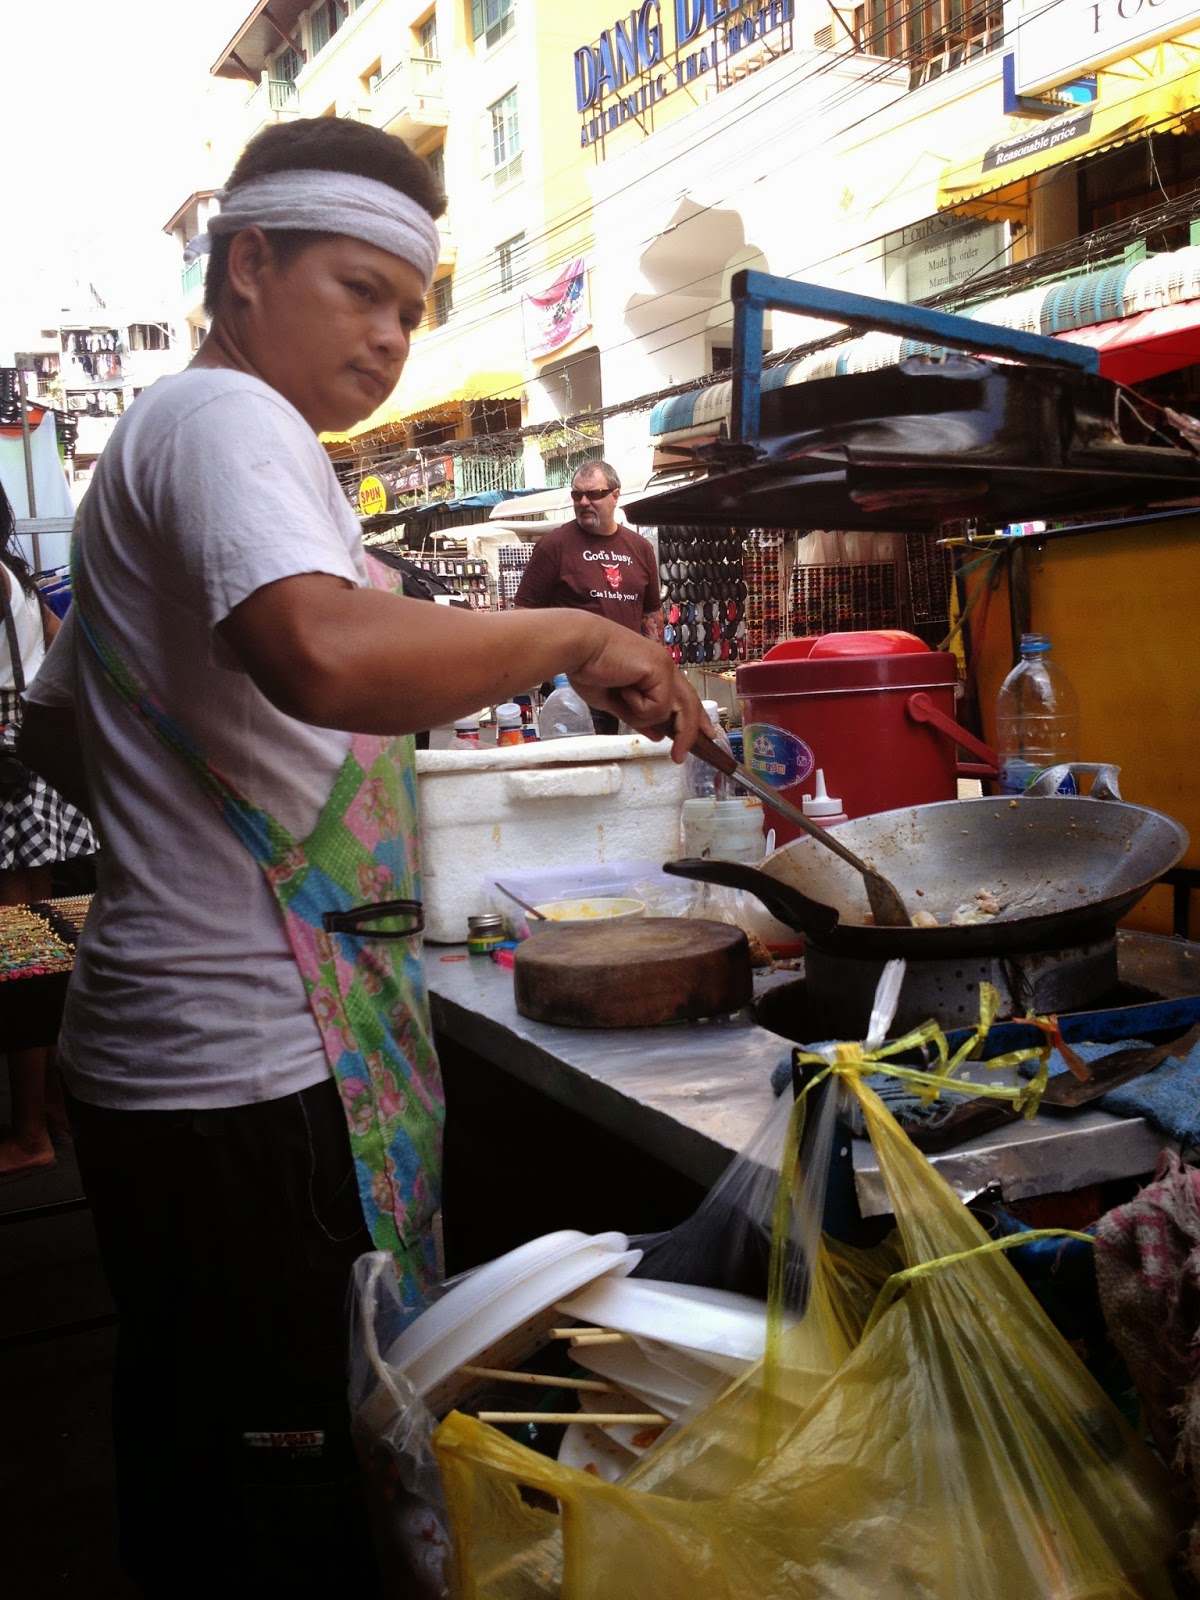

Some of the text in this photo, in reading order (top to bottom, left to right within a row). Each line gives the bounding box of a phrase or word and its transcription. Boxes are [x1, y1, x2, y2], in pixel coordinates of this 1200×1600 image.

[574, 0, 663, 114] DANG
[581, 73, 667, 148] AUTHENTIC
[674, 41, 718, 88] THAI
[728, 0, 795, 55] HOTEL
[995, 136, 1050, 166] Reasonable
[1050, 125, 1077, 147] price
[928, 257, 948, 272] Made
[959, 246, 979, 261] order
[929, 268, 974, 288] Manufacturer
[360, 486, 381, 504] SPUN
[583, 550, 633, 565] God's busy.
[590, 589, 603, 598] Can
[608, 590, 622, 601] help
[623, 593, 638, 601] you?
